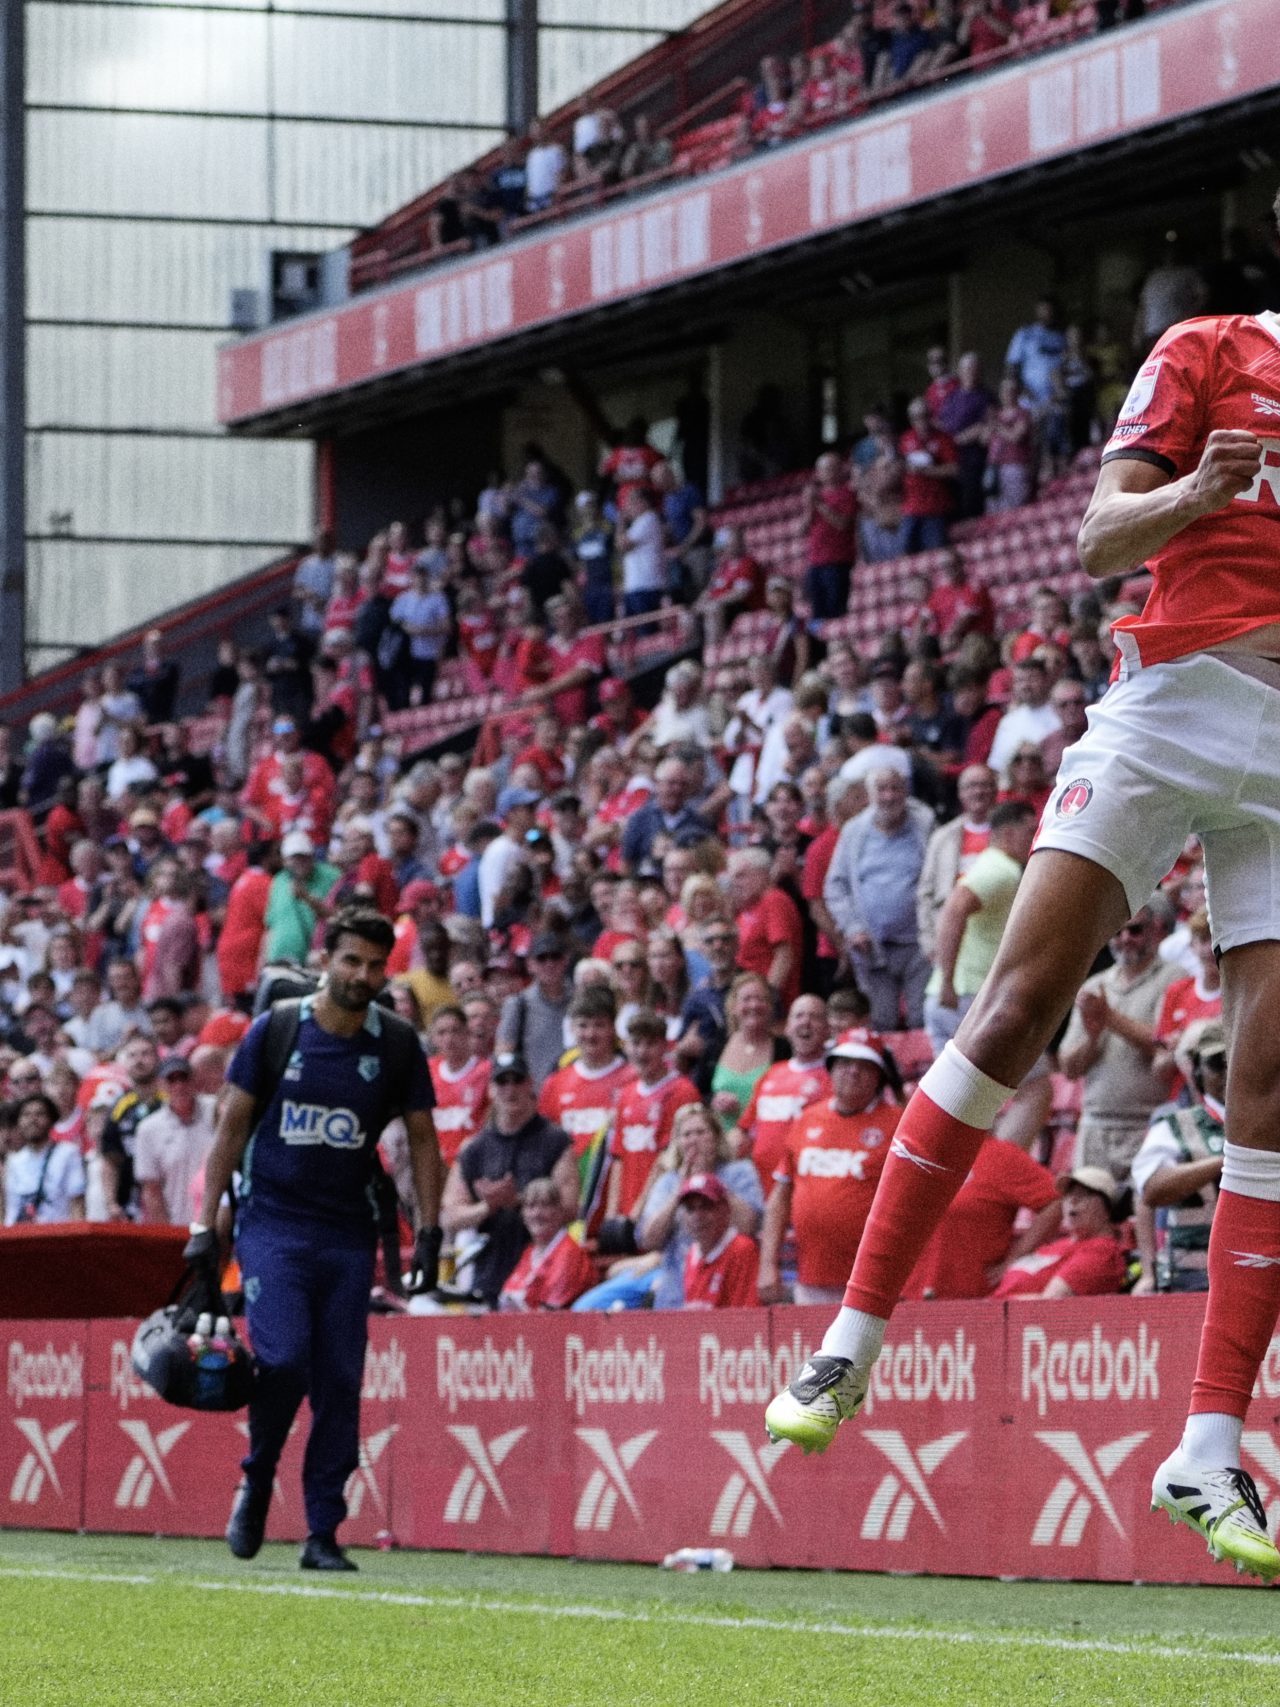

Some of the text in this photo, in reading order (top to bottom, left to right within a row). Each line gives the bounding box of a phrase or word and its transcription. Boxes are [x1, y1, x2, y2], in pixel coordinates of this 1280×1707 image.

[282, 1102, 364, 1148] MrQ
[437, 1336, 533, 1412] Reebok
[566, 1334, 665, 1414] Reebok
[864, 1328, 977, 1415] eebok
[1022, 1323, 1159, 1415] Reebok
